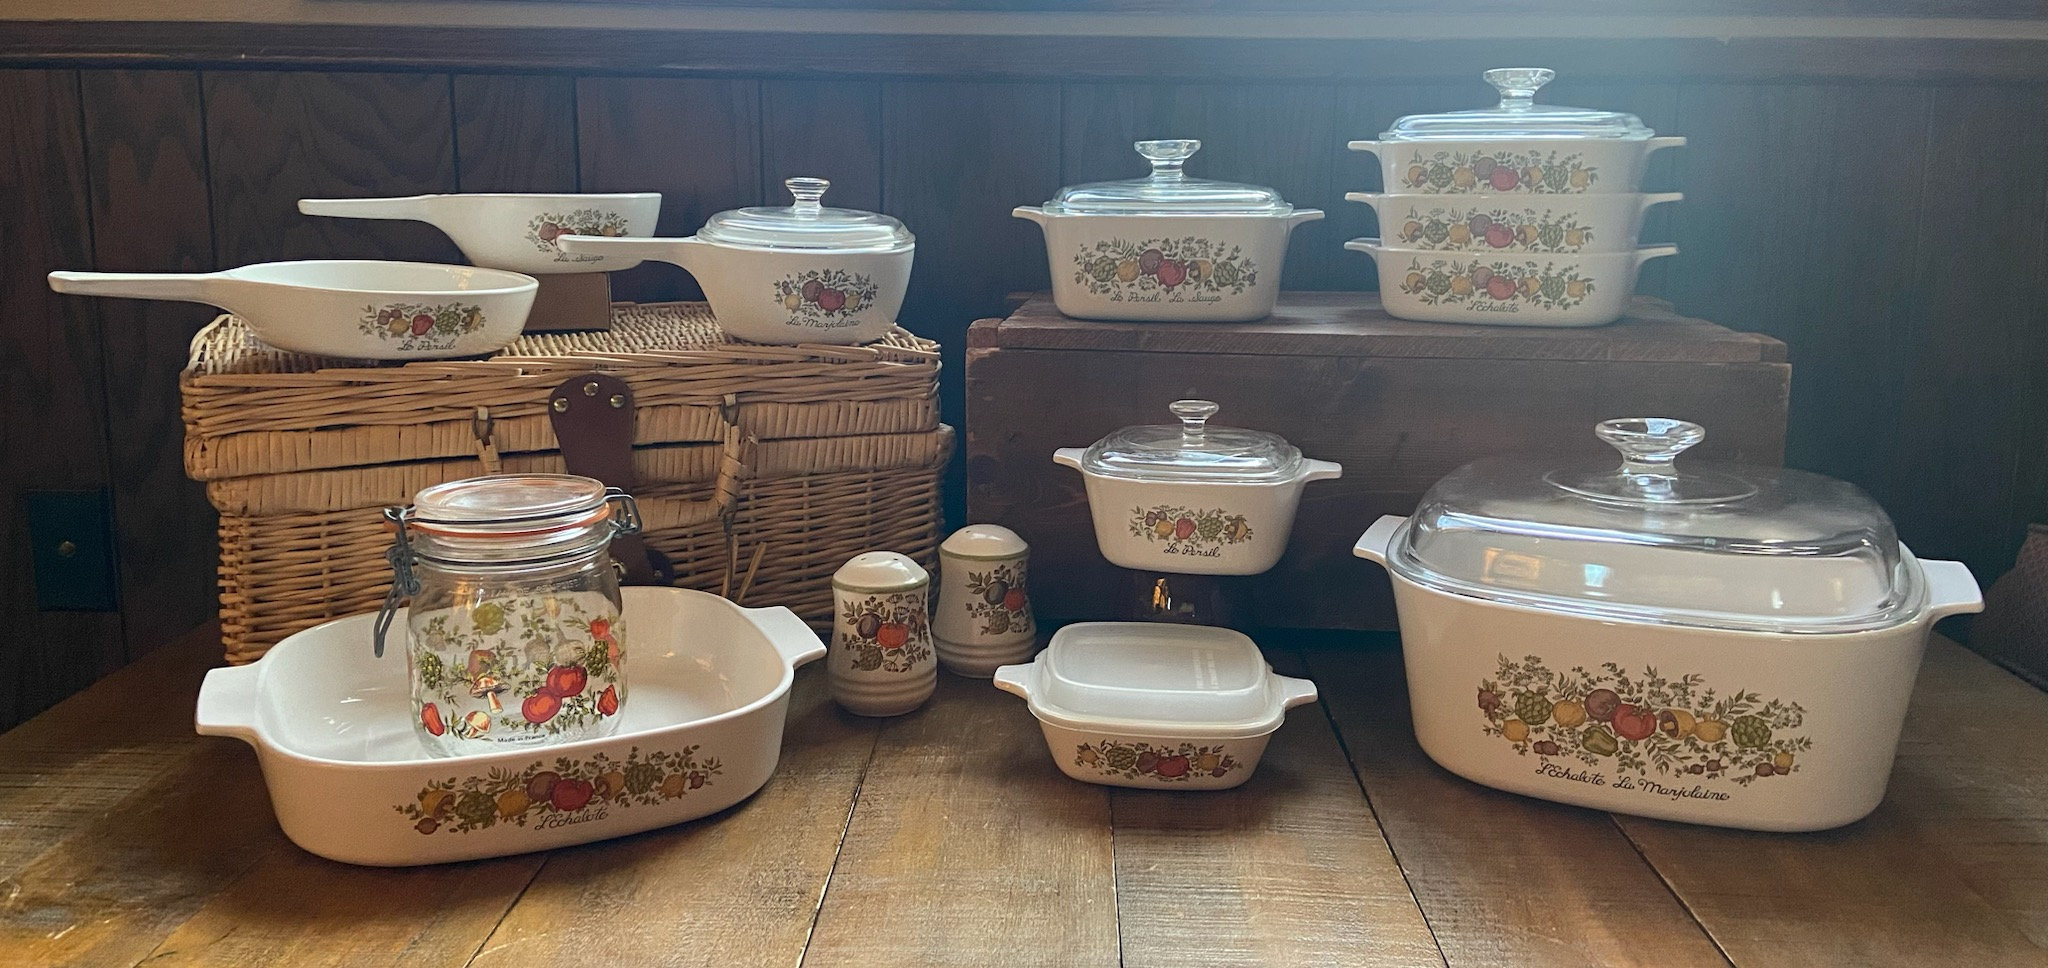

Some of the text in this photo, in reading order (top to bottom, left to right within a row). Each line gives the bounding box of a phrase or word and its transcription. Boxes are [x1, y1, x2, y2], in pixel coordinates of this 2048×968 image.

[1163, 542, 1221, 558] Le Persil
[1612, 775, 1635, 789] La
[1637, 778, 1731, 801] Marjolaine
